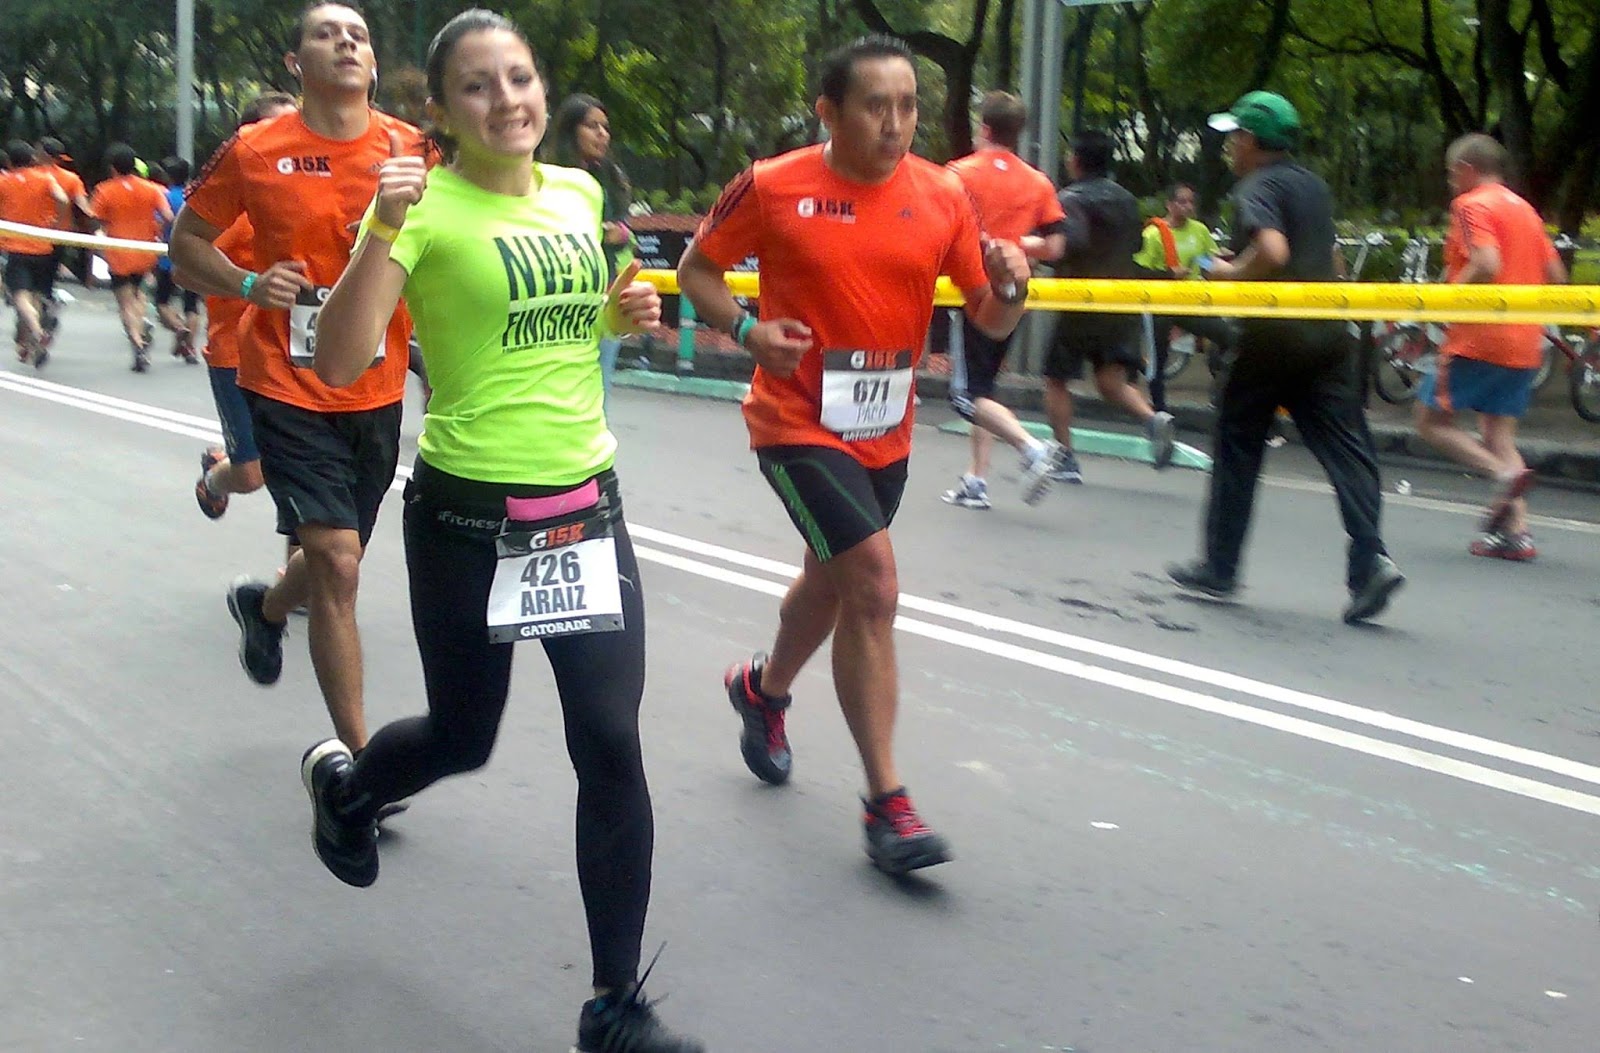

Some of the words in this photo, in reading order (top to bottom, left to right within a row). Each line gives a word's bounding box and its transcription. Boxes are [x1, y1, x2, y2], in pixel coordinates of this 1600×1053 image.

[853, 377, 890, 404] 671
[529, 521, 586, 549] G15K
[520, 551, 582, 588] 426
[520, 585, 587, 617] ARAIZ
[520, 618, 592, 637] GATORADE
